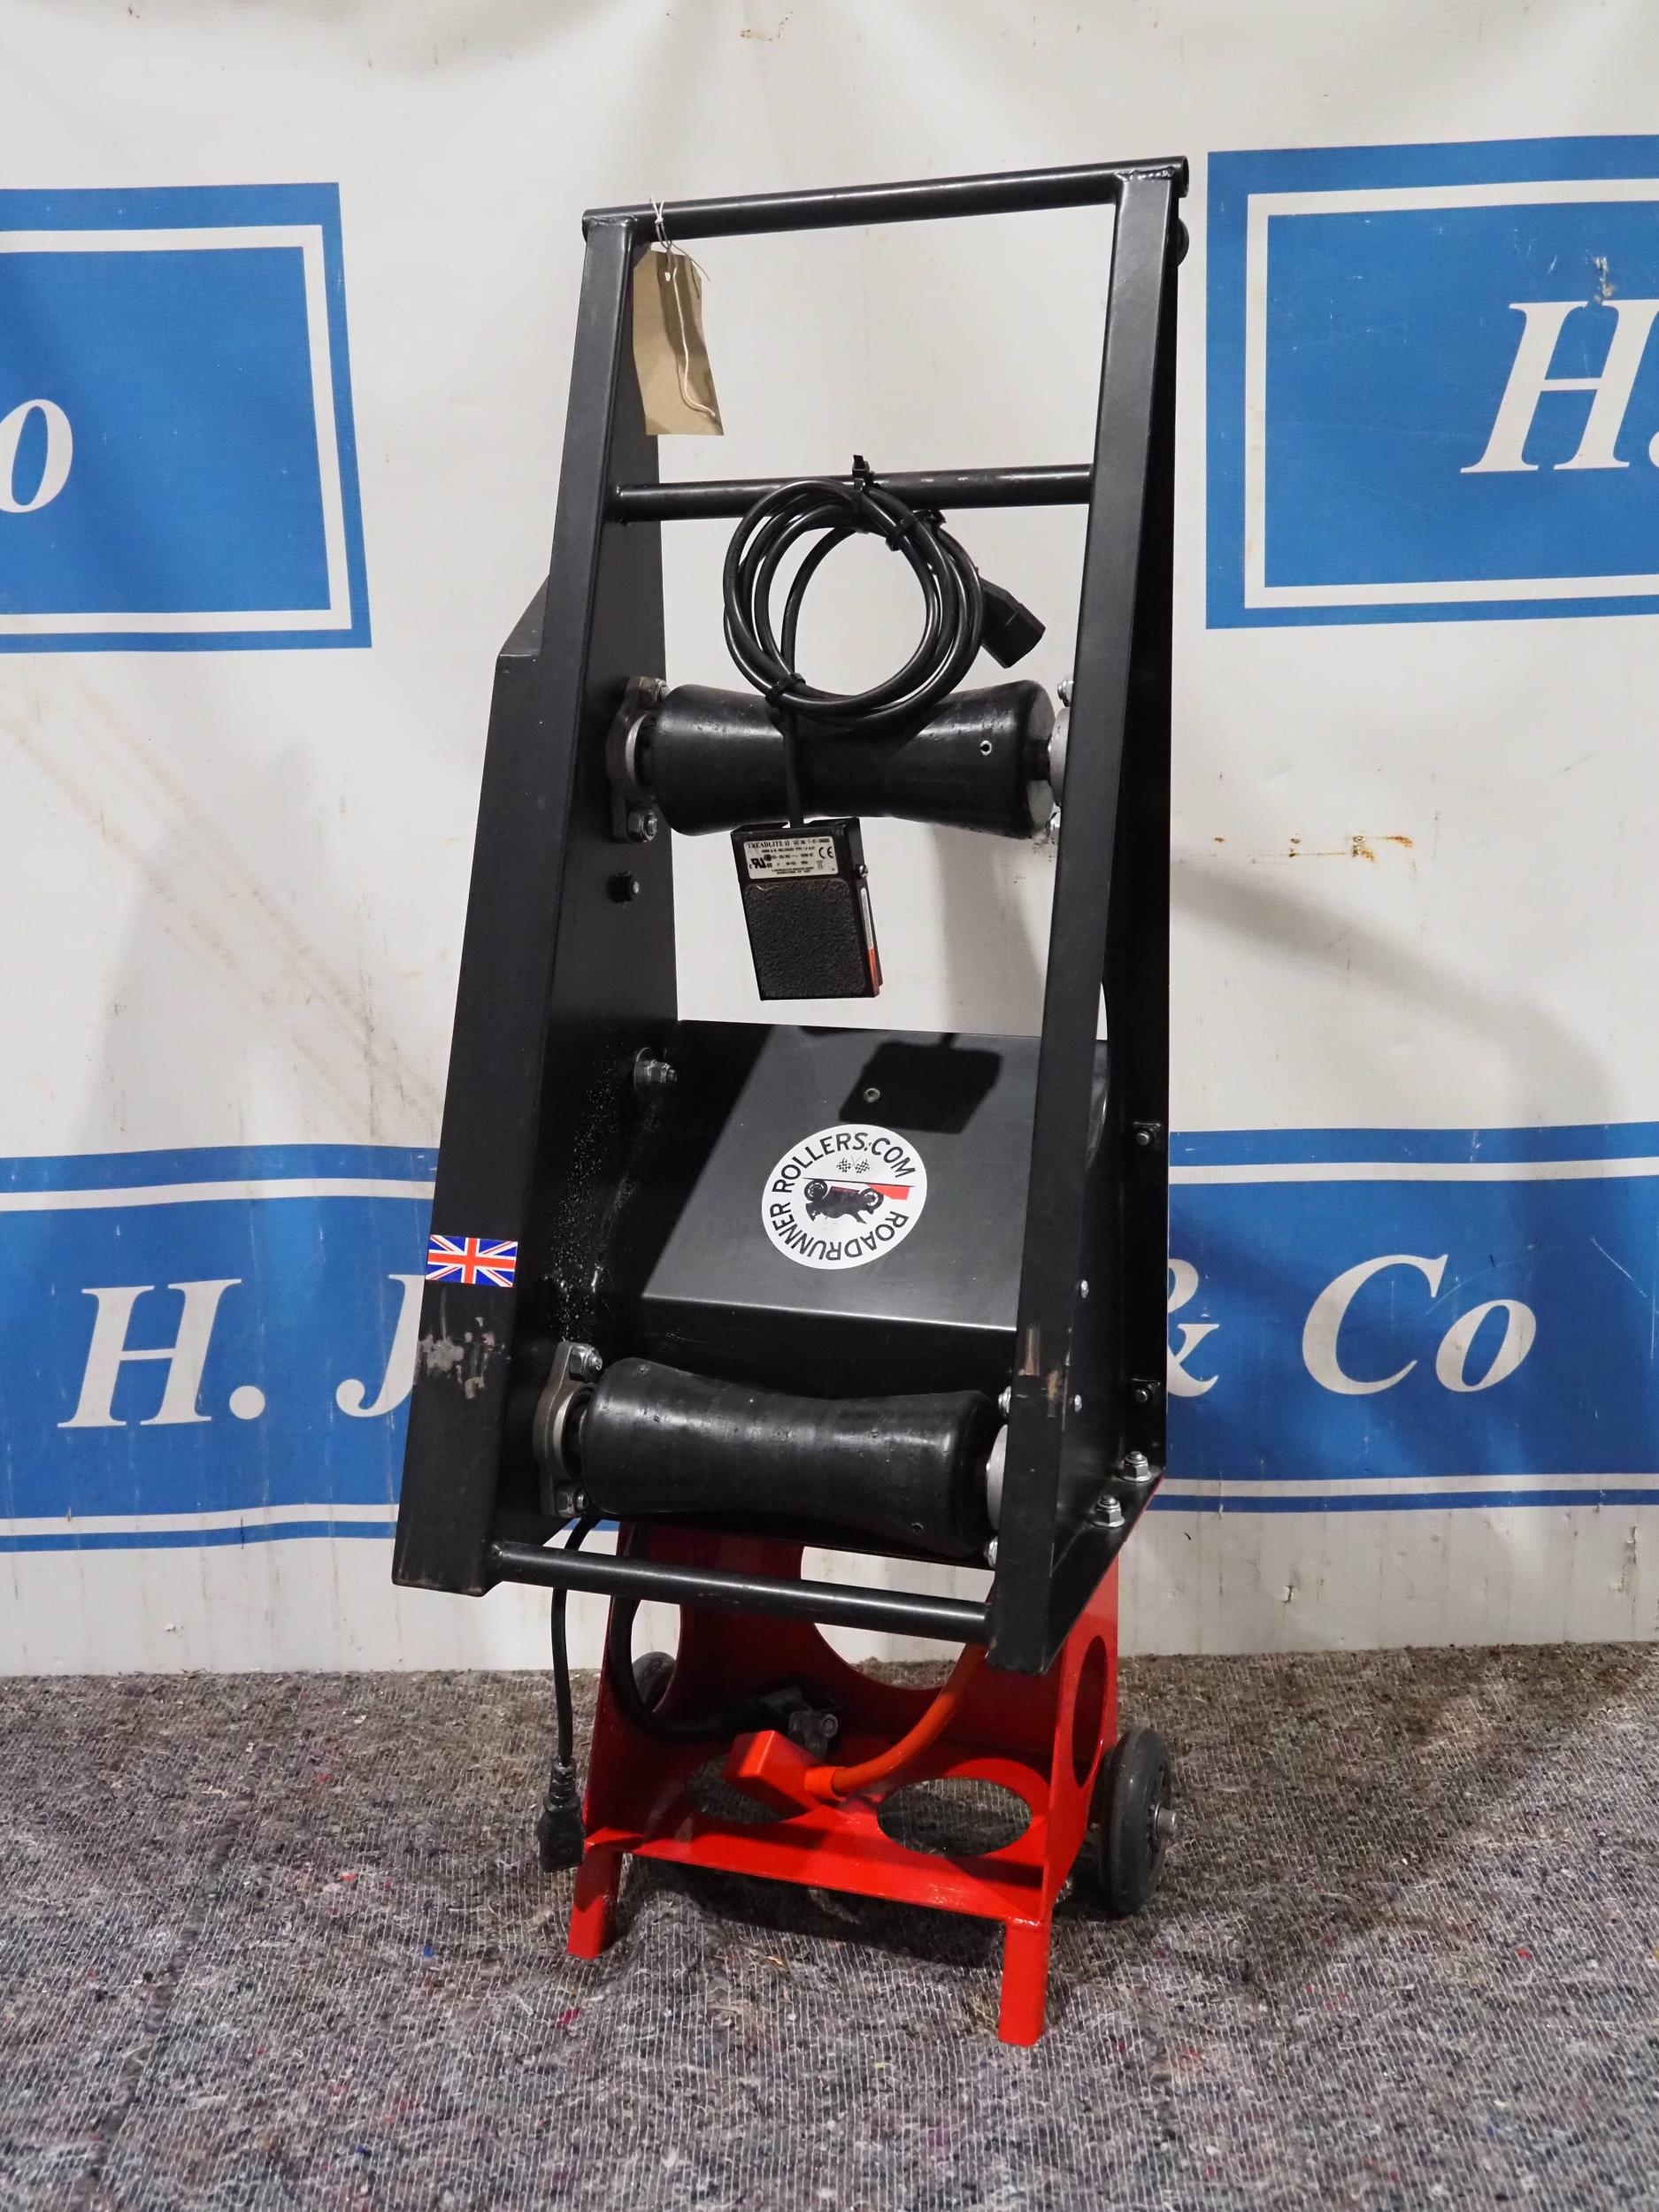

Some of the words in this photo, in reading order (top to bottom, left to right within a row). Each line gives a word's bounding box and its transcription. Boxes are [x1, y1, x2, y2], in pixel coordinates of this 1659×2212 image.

[1461, 298, 1659, 474] H
[772, 1132, 916, 1194] ROLLERS.COM
[770, 1202, 910, 1261] ROADRUNNER
[58, 1279, 265, 1428] H.
[1302, 1254, 1537, 1395] Co
